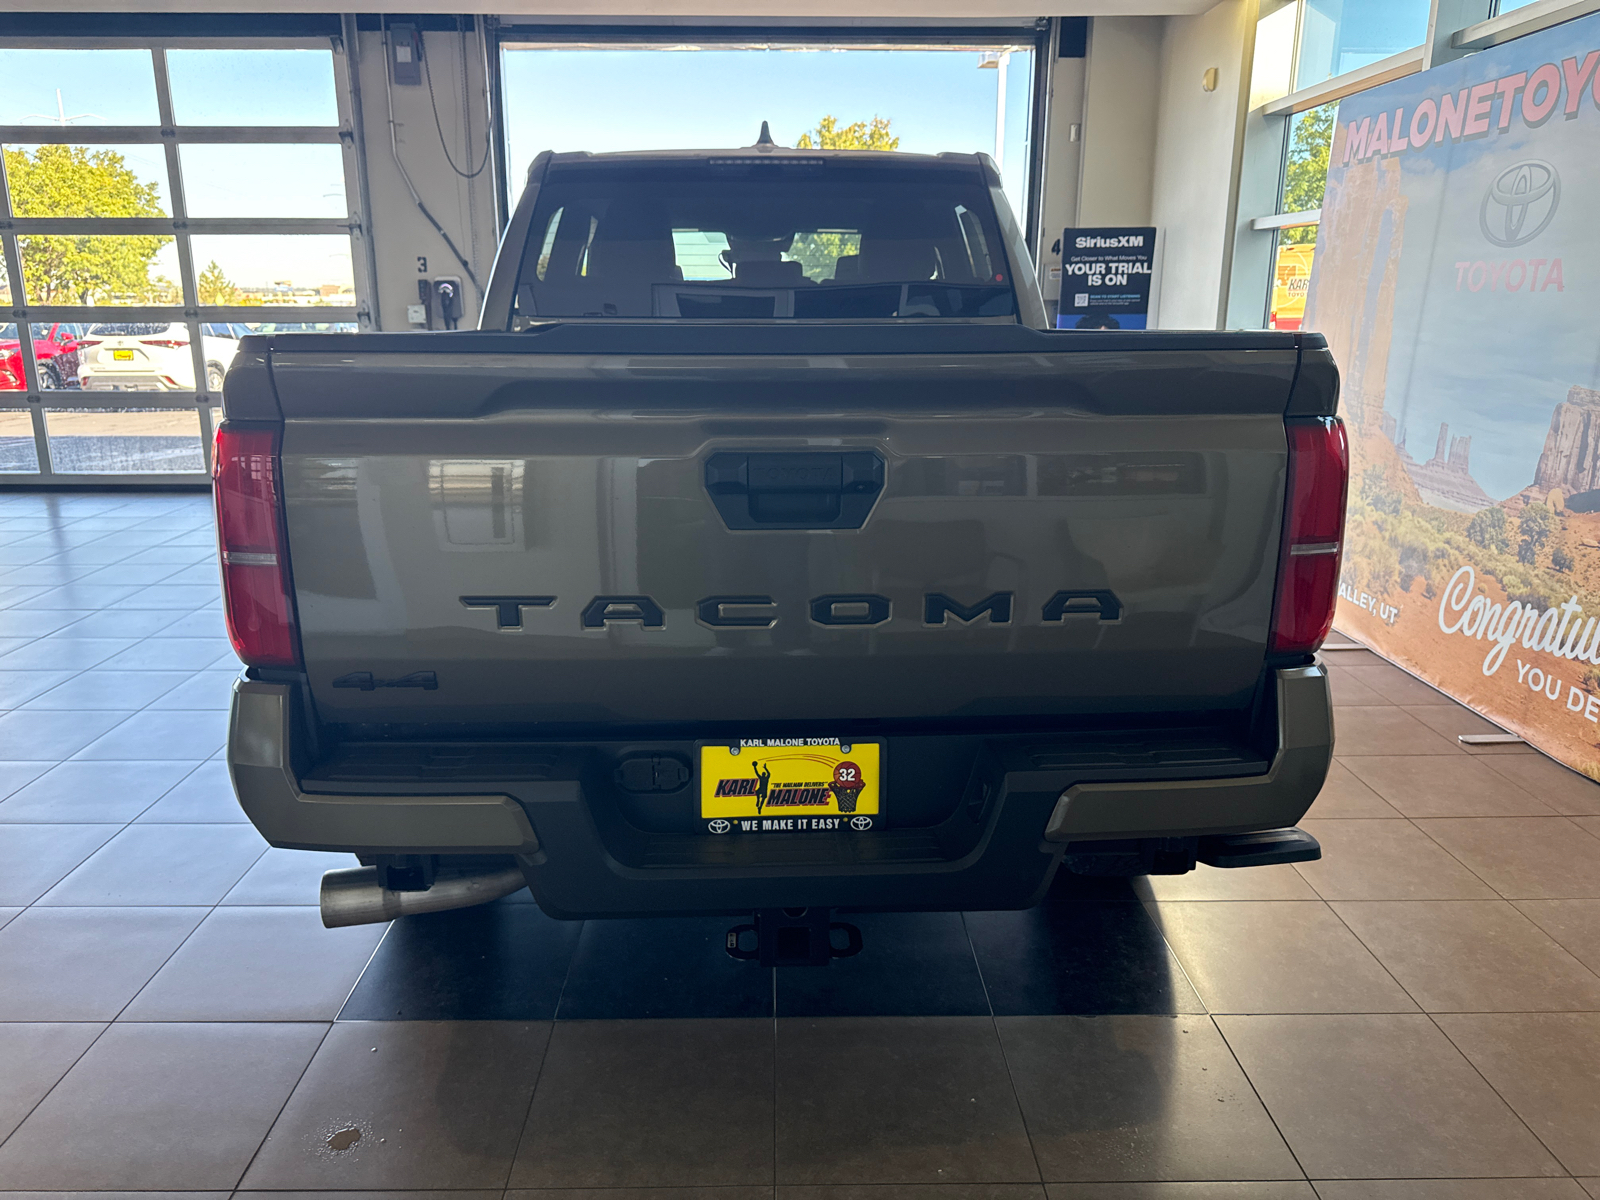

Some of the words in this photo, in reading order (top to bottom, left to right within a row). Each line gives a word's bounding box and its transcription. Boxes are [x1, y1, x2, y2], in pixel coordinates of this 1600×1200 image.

[1343, 49, 1600, 167] MALONETOY
[1051, 238, 1061, 256] 4
[1075, 236, 1144, 248] SiriusXM
[417, 256, 428, 273] 3
[1065, 263, 1106, 275] YOUR
[1108, 262, 1152, 274] TRIAL
[1087, 274, 1102, 286] IS
[1104, 274, 1128, 286] ON
[1454, 258, 1565, 292] TOYOTA
[753, 467, 835, 481] TOYOTA
[459, 589, 1124, 632] TACOMA
[1337, 580, 1377, 617] ALLEY,
[1379, 602, 1398, 624] UT
[1516, 659, 1562, 700] YOU
[740, 738, 765, 747] KARL
[766, 738, 804, 747] MALONE
[805, 737, 841, 746] TOYOTA
[839, 768, 856, 781] 32
[714, 778, 759, 798] KARL
[766, 787, 832, 807] MALONE
[741, 820, 758, 831] WE
[762, 819, 794, 831] MAKE
[797, 818, 808, 830] IT
[811, 818, 841, 830] EASY
